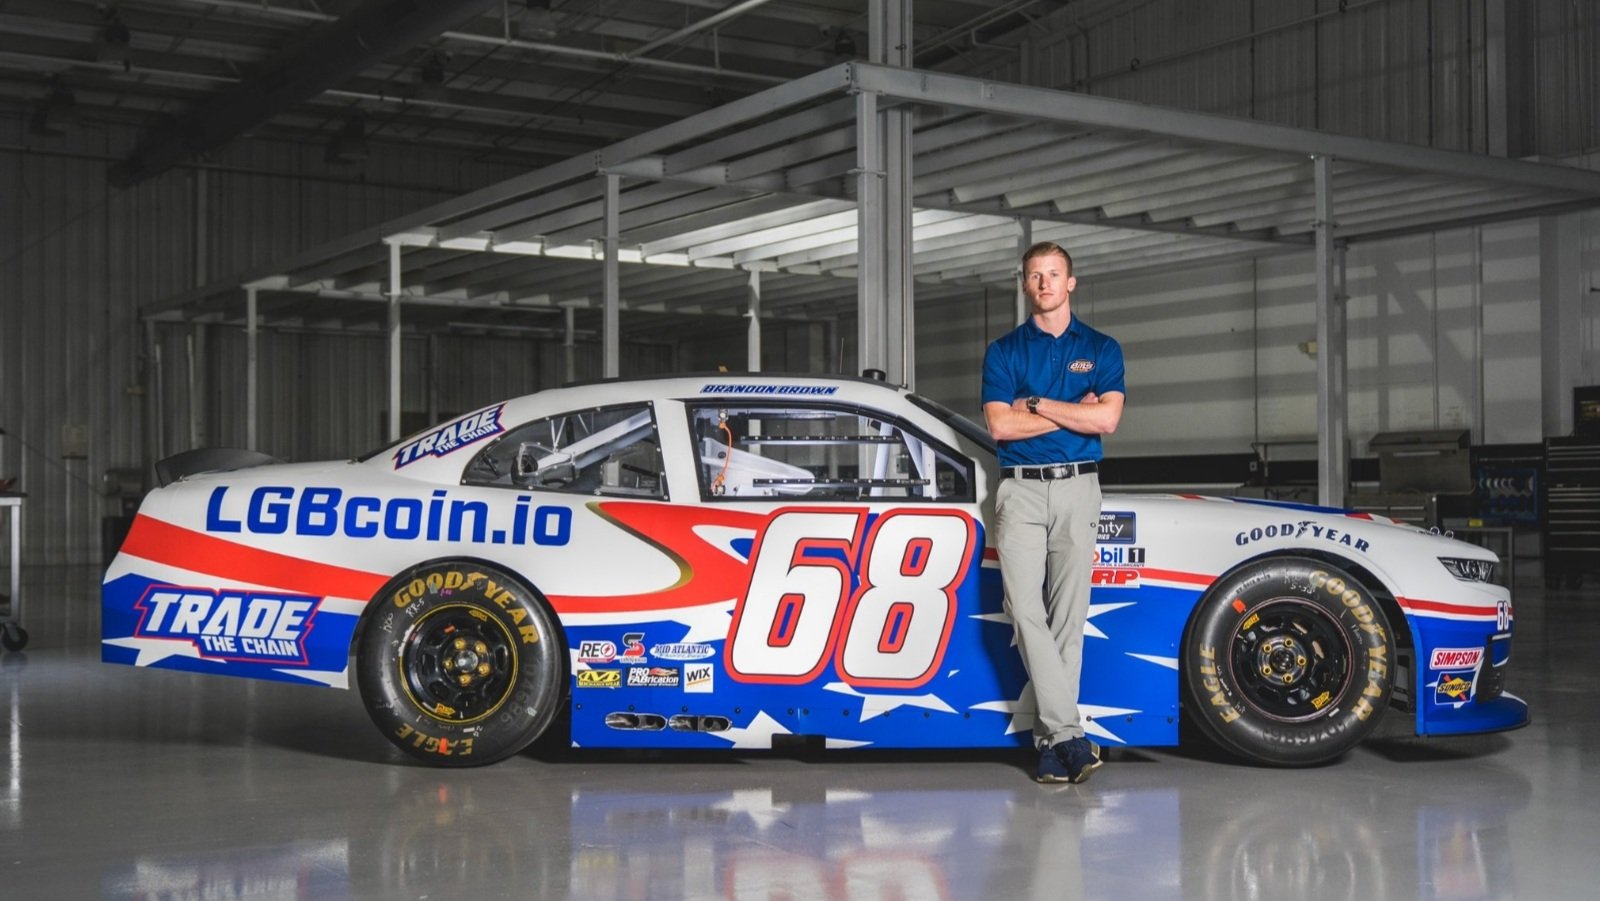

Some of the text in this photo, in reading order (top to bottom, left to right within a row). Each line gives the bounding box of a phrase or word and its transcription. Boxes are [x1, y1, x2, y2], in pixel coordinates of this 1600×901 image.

[702, 385, 837, 394] BRANDON BROWN
[400, 406, 500, 464] TRADE
[435, 423, 498, 453] THE CHAIN
[206, 486, 573, 546] LGBcoin.io
[1098, 521, 1124, 537] nity
[1235, 520, 1370, 553] GOODYEAR
[1093, 547, 1142, 563] bil 1
[1091, 570, 1138, 584] RP
[393, 571, 540, 645] GOODYEAR
[723, 506, 977, 689] 68
[145, 592, 313, 640] TRADE
[1497, 601, 1510, 631] 68
[201, 636, 300, 657] THE CHAIN
[654, 644, 710, 655] MID ATLANTIC
[1308, 570, 1387, 722] GOODYEAR
[1434, 652, 1480, 666] SIMPSON
[630, 667, 650, 676] PRO
[686, 667, 710, 682] WIX
[1200, 643, 1241, 724] EAGLE
[1438, 682, 1472, 693] SUNOCO
[395, 722, 475, 755] EAGLE
